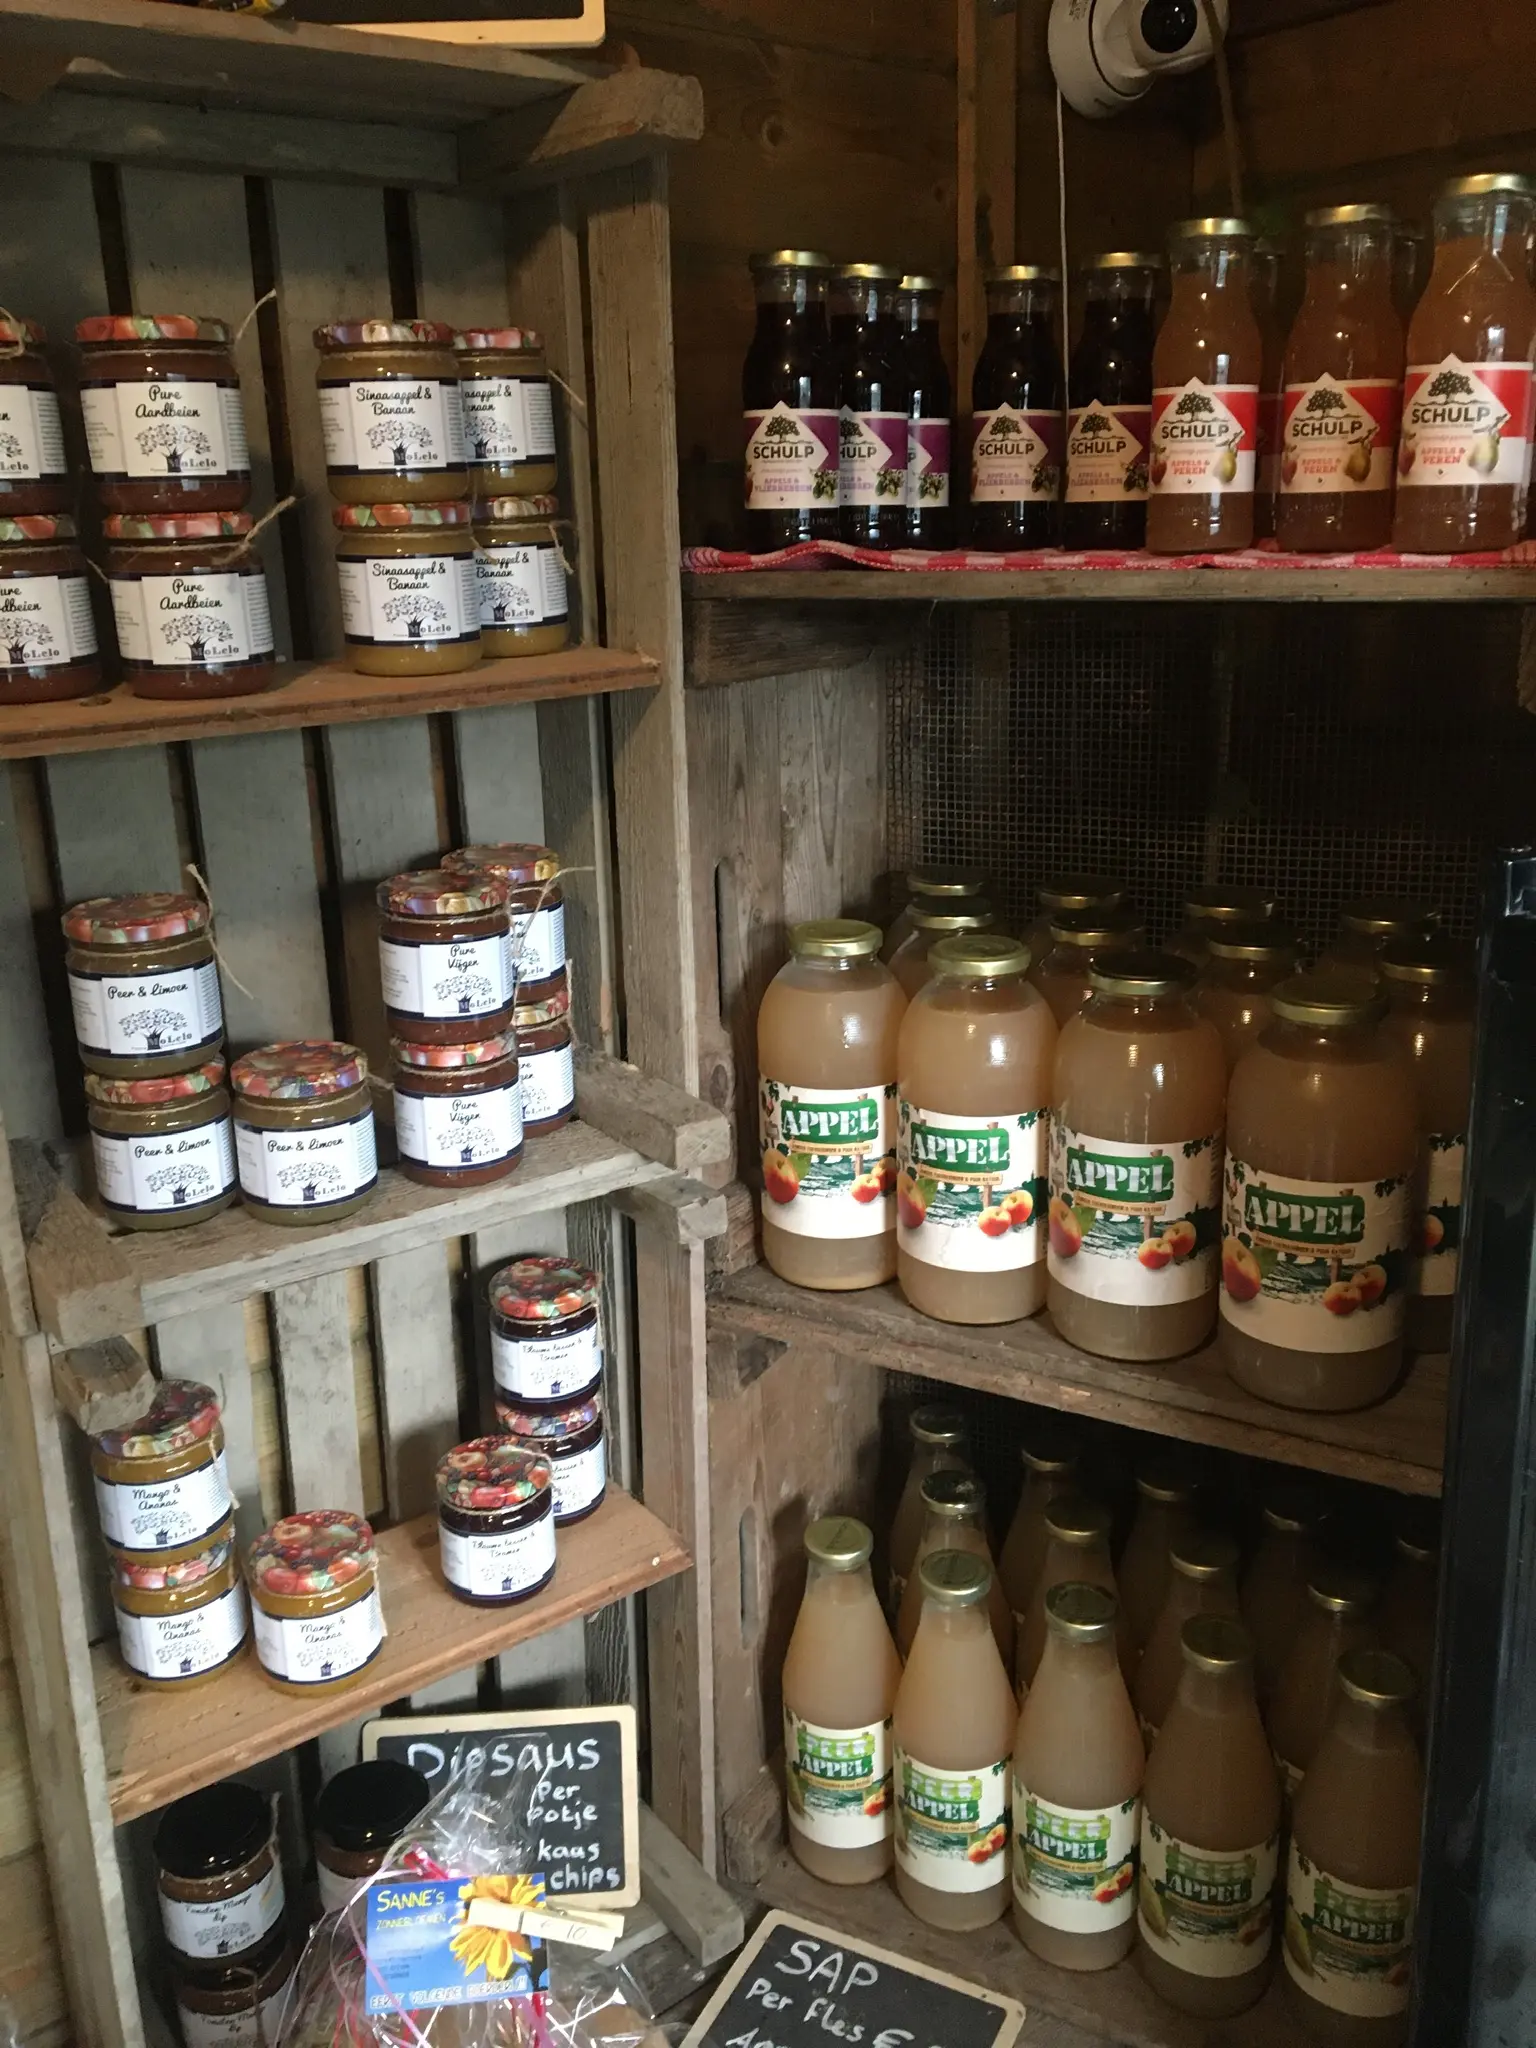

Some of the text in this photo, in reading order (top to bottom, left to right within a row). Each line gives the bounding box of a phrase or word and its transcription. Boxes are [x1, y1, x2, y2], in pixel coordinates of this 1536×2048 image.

[149, 385, 182, 401] Pure
[356, 385, 432, 404] Sinaasappel &
[465, 384, 512, 402] asappel &
[135, 403, 200, 418] Aardbeien
[371, 402, 415, 416] Banaan
[1411, 407, 1490, 424] SCHULP
[1161, 424, 1229, 439] SCHULP
[1292, 420, 1363, 437] SCHULP
[753, 446, 814, 459] SCHULP
[839, 446, 878, 459] HULP
[979, 443, 1035, 456] SCHULP
[1071, 441, 1127, 455] SCHULP
[522, 552, 529, 563] &
[372, 561, 446, 579] Sinaasappel &
[476, 567, 513, 578] Banaan
[172, 579, 204, 594] Pure
[387, 577, 430, 590] Banaan
[0, 587, 22, 596] ure
[0, 598, 41, 612] dbeien
[160, 595, 223, 610] Aardbeien
[450, 945, 476, 957] Pure
[448, 959, 479, 972] Vijgen
[107, 985, 136, 999] Peer
[138, 986, 147, 997] &
[452, 1099, 478, 1111] Pure
[450, 1113, 481, 1125] Vijgen
[782, 1107, 879, 1136] APPEL
[134, 1145, 163, 1158] Peer
[165, 1144, 174, 1155] &
[268, 1140, 293, 1152] Peer
[295, 1141, 304, 1151] &
[912, 1133, 1010, 1164] APPEL
[1068, 1158, 1174, 1194] APPEL
[1245, 1196, 1364, 1236] APPEL
[132, 1483, 181, 1501] Mango &
[138, 1500, 179, 1510] Ananas
[157, 1612, 204, 1631] Mango &
[300, 1622, 335, 1634] Mango
[163, 1628, 201, 1640] Ananas
[407, 1738, 601, 1779] Dipsaus
[801, 1753, 868, 1777] APPEL
[905, 1791, 974, 1820] APPEL
[527, 1803, 598, 1830] potje
[538, 1839, 600, 1862] kaas
[1029, 1828, 1101, 1860] APPEL
[550, 1864, 621, 1890] chips
[1167, 1874, 1247, 1902] APPEL
[774, 1939, 879, 1995] SAP
